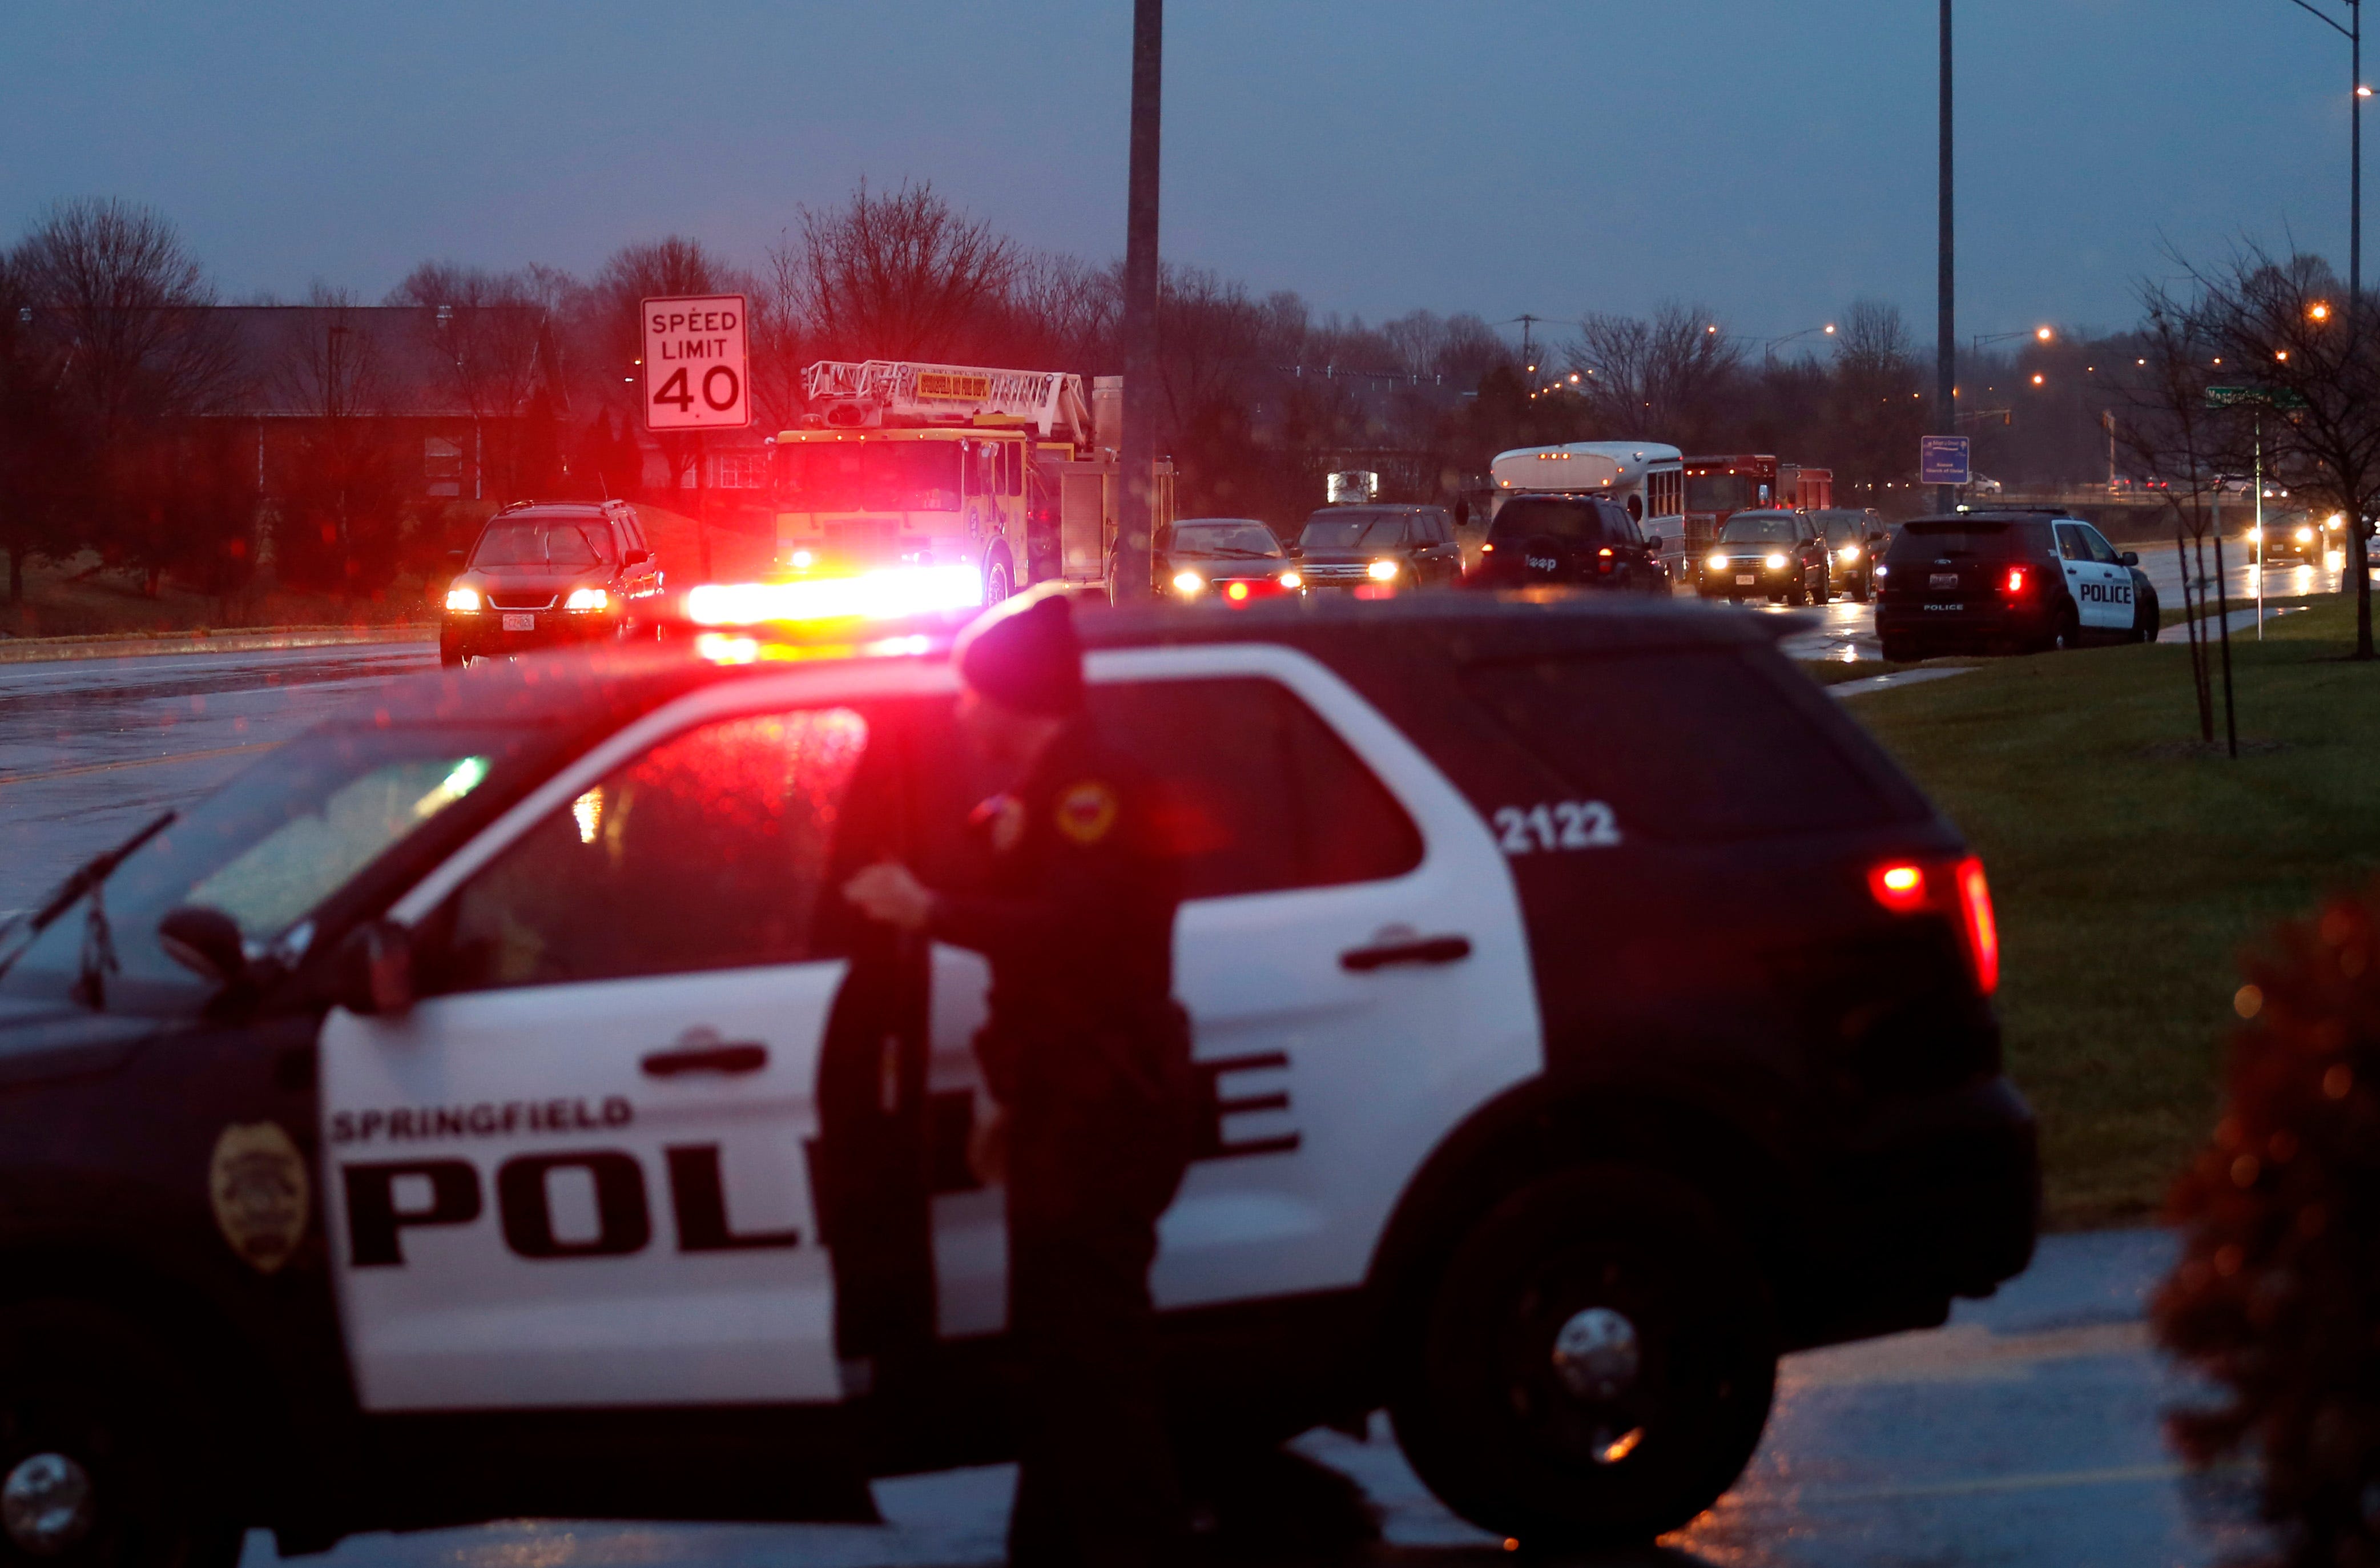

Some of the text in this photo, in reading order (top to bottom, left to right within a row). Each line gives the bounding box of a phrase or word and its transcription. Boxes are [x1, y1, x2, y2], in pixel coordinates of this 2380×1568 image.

[653, 312, 736, 333] SPEED
[662, 339, 727, 360] LIMIT
[653, 365, 739, 412] 40
[2080, 584, 2131, 604] POLICE
[1493, 800, 1621, 853] 2122
[334, 1096, 633, 1142] SPRINGFIELD
